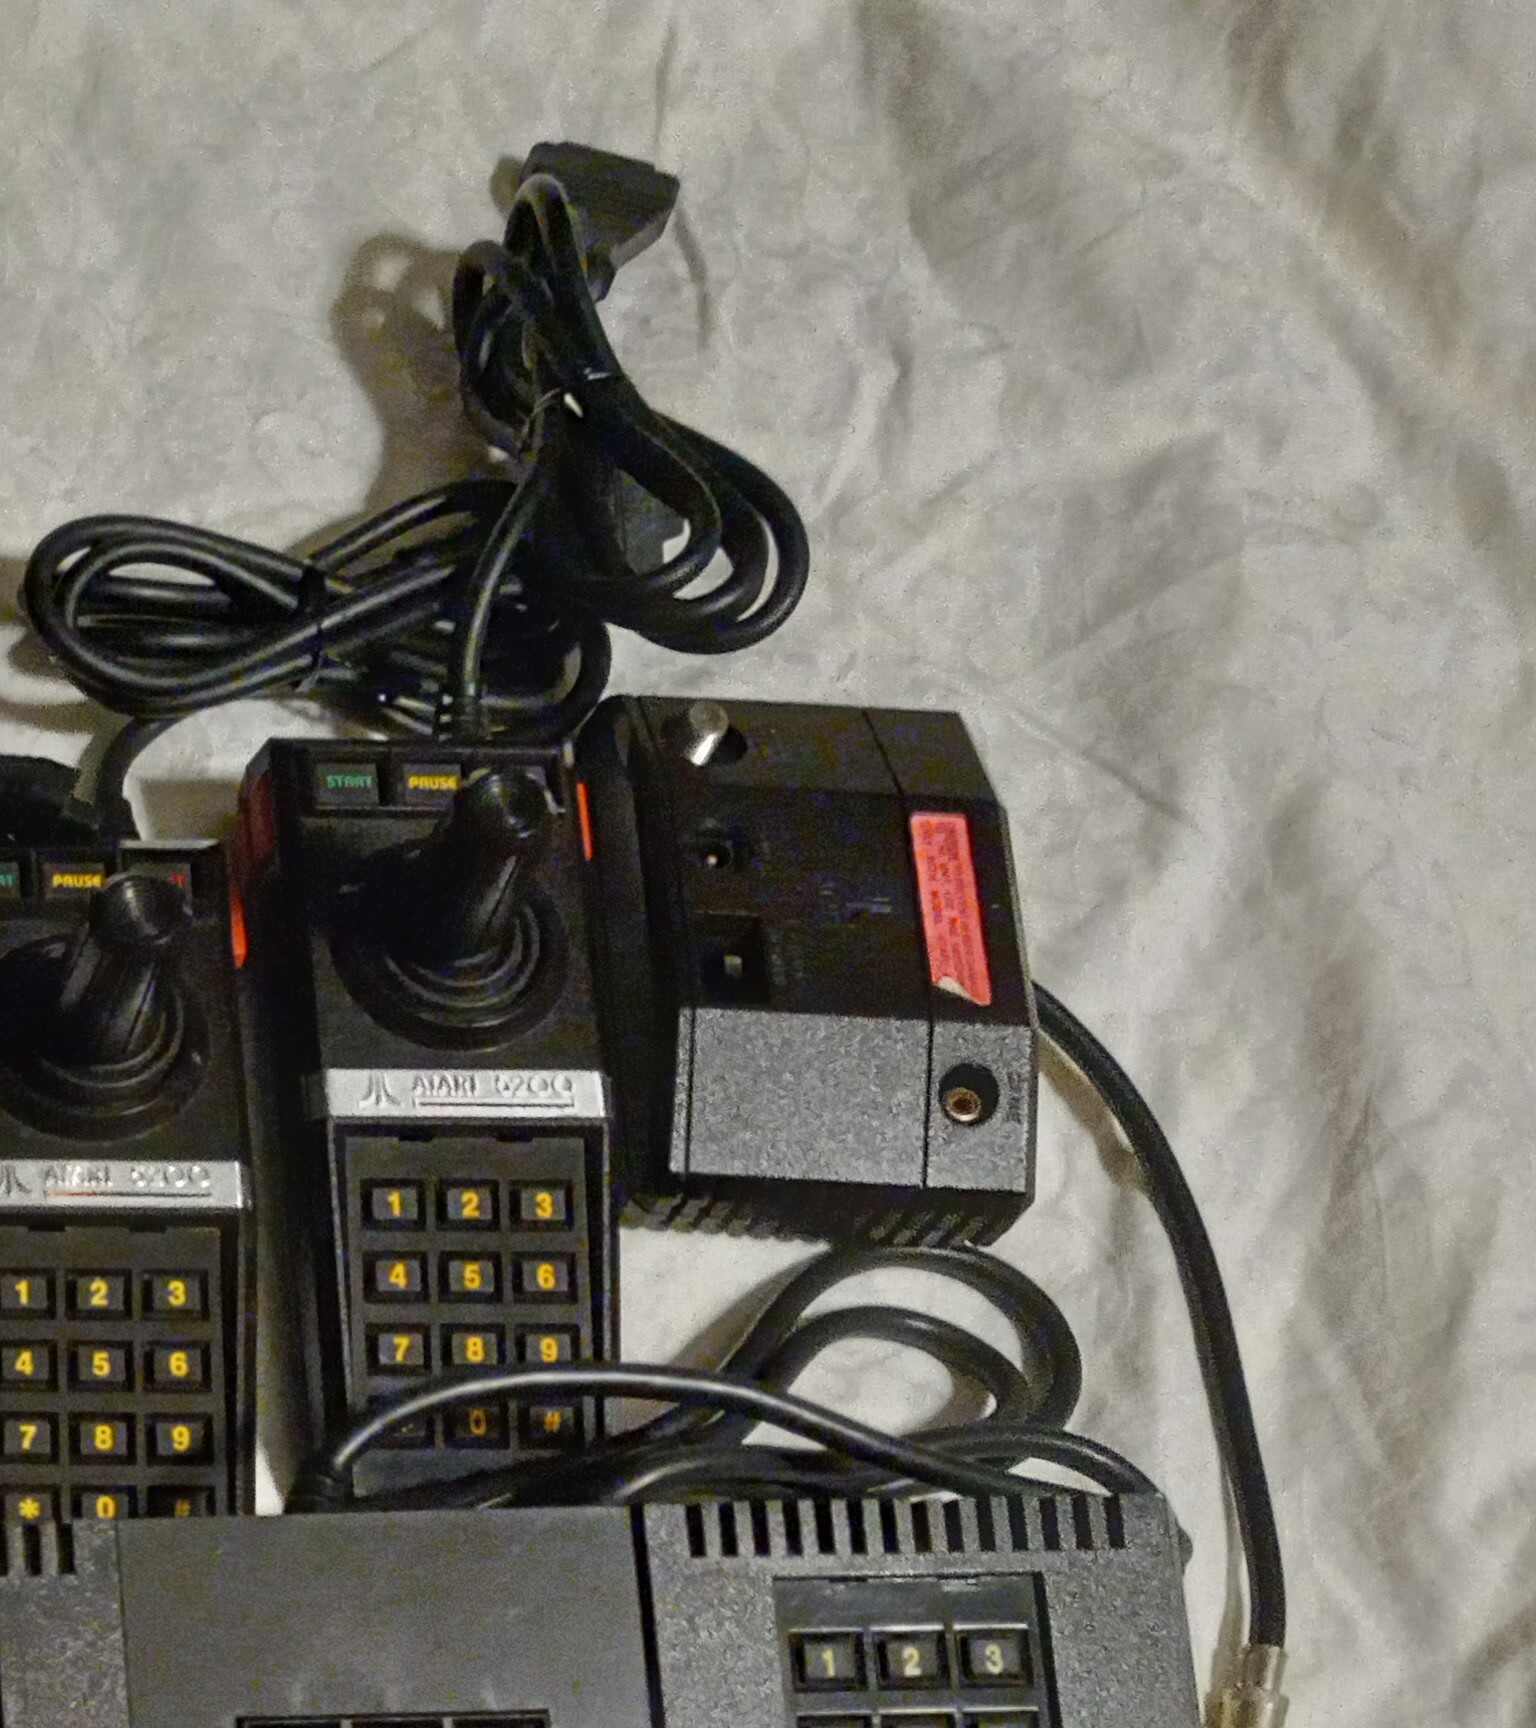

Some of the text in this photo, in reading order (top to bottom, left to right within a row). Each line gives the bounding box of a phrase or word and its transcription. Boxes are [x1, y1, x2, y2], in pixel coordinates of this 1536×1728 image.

[408, 774, 458, 790] PAUSE
[52, 872, 102, 889] PAUSE
[388, 1189, 554, 1219] 1 2 3
[388, 1261, 556, 1290] 4 5 6
[15, 1278, 187, 1307] 1 2 3
[14, 1349, 189, 1377] 4 5 6
[393, 1334, 559, 1363] 7 8 9
[19, 1422, 192, 1452] 7 8 9
[821, 1643, 1004, 1677] 1 2 3
